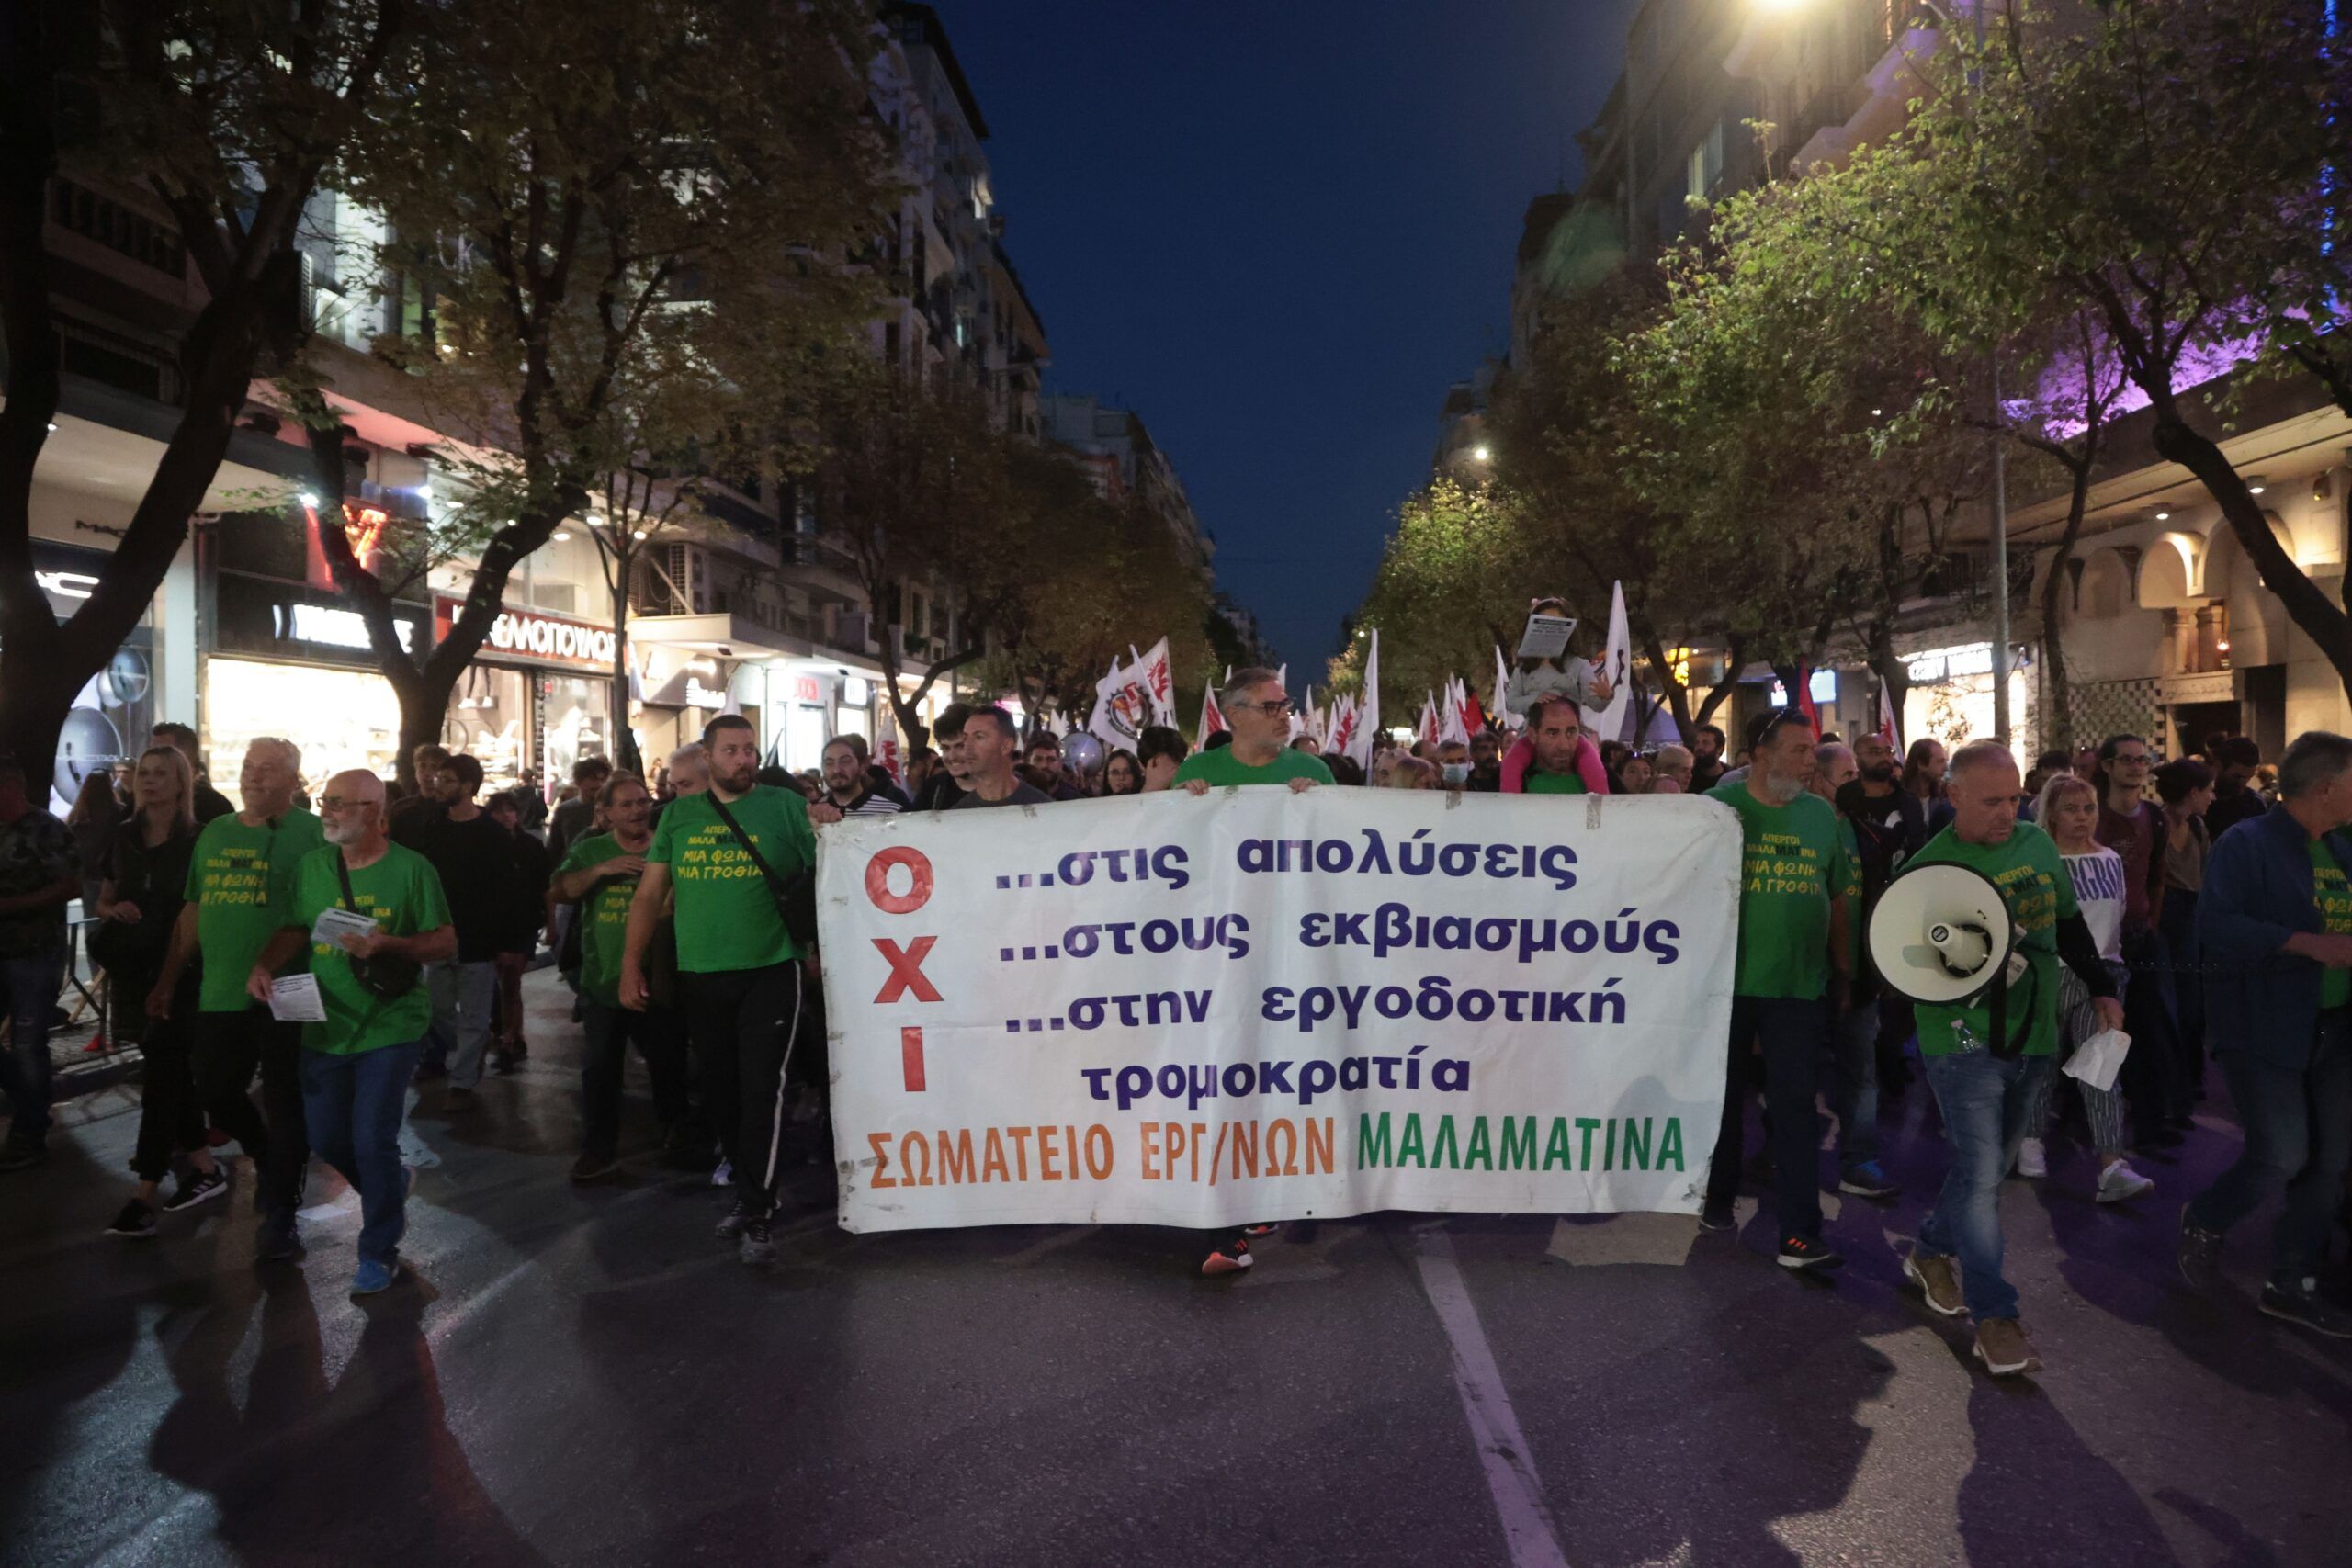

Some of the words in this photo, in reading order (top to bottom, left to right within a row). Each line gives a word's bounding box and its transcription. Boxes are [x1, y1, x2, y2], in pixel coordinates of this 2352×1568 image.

[683, 850, 707, 863] ΜΙΑ
[711, 849, 752, 864] ΦΩΝ
[996, 844, 1189, 890] ...στις
[1237, 829, 1577, 891] απολύσεις
[1000, 913, 1250, 962] ...στους
[1299, 902, 1679, 965] εκβιασμούς
[1006, 989, 1213, 1032] ...στην
[1261, 976, 1625, 1032] εργοδοτική
[1081, 1044, 1470, 1111] τρομοκρατία
[867, 1122, 1114, 1190] ΣΩΜΑΤΕΙΟ
[1140, 1116, 1335, 1187] ΕΡΓ/ΝΩΝ
[1359, 1111, 1685, 1172] ΜΑΛΑΜΑΤΙΝΑ
